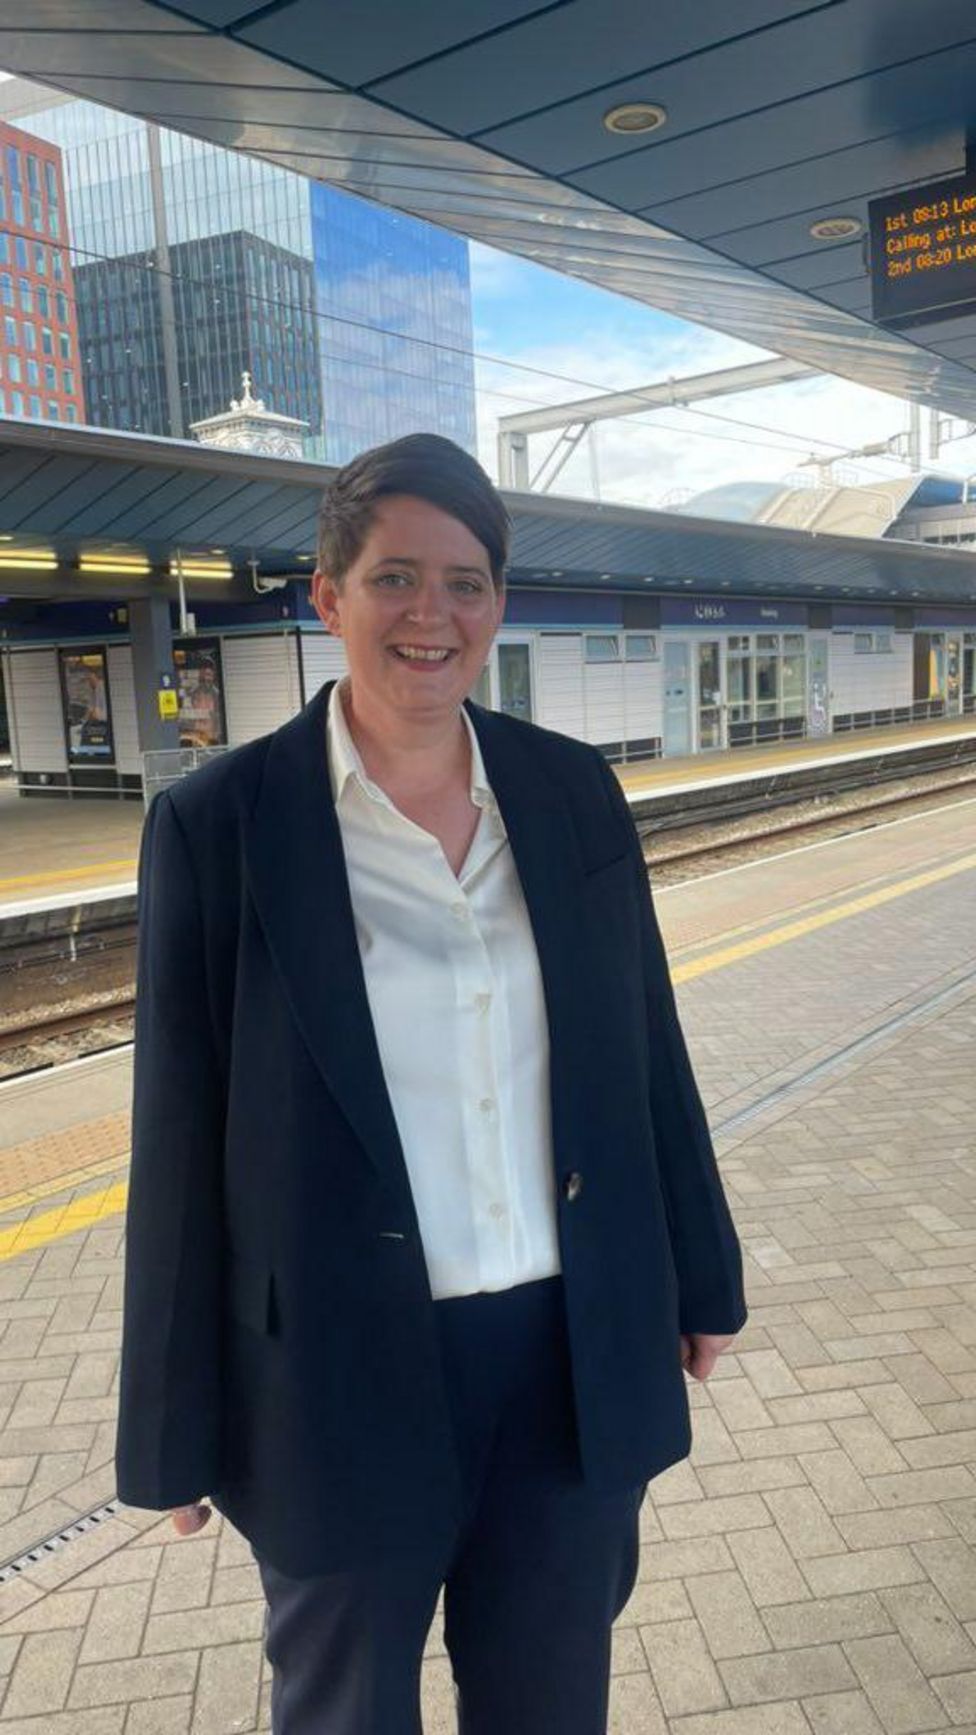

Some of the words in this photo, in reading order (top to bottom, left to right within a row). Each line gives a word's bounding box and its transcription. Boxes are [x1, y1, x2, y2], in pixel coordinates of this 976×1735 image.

[886, 212, 908, 232] 1st
[912, 201, 948, 224] 08:13
[886, 233, 931, 254] Calling
[936, 225, 956, 241] at:
[888, 257, 912, 277] 2nd
[916, 248, 952, 269] 08:20
